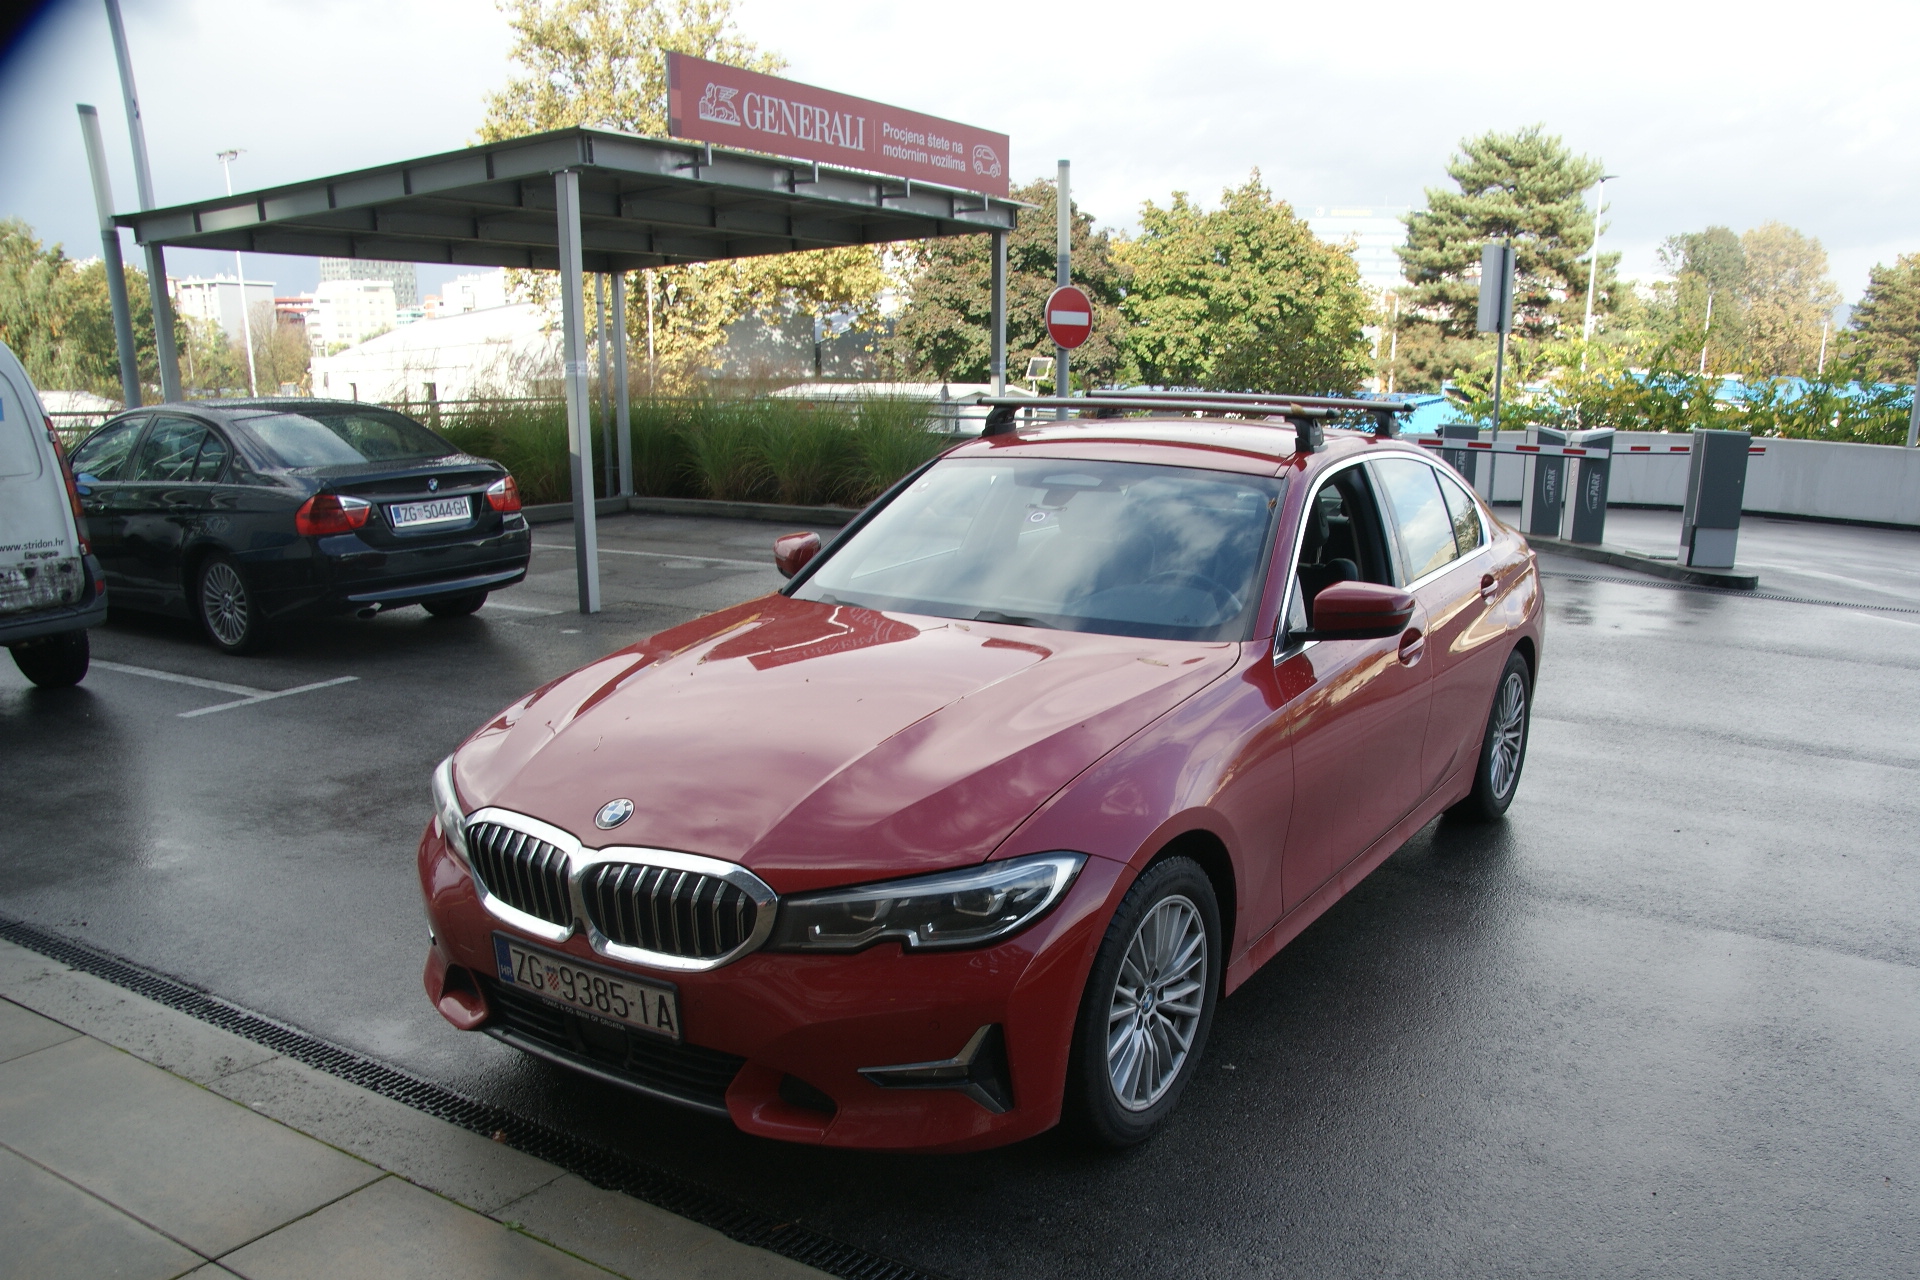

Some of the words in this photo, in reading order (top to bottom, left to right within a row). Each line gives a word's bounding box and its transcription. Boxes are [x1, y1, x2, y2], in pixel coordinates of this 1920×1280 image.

[742, 92, 865, 151] GENERALI
[883, 122, 925, 146] Procjena
[927, 132, 950, 152] štete
[952, 141, 963, 155] na
[883, 144, 928, 165] motornim
[930, 154, 966, 173] vozilima
